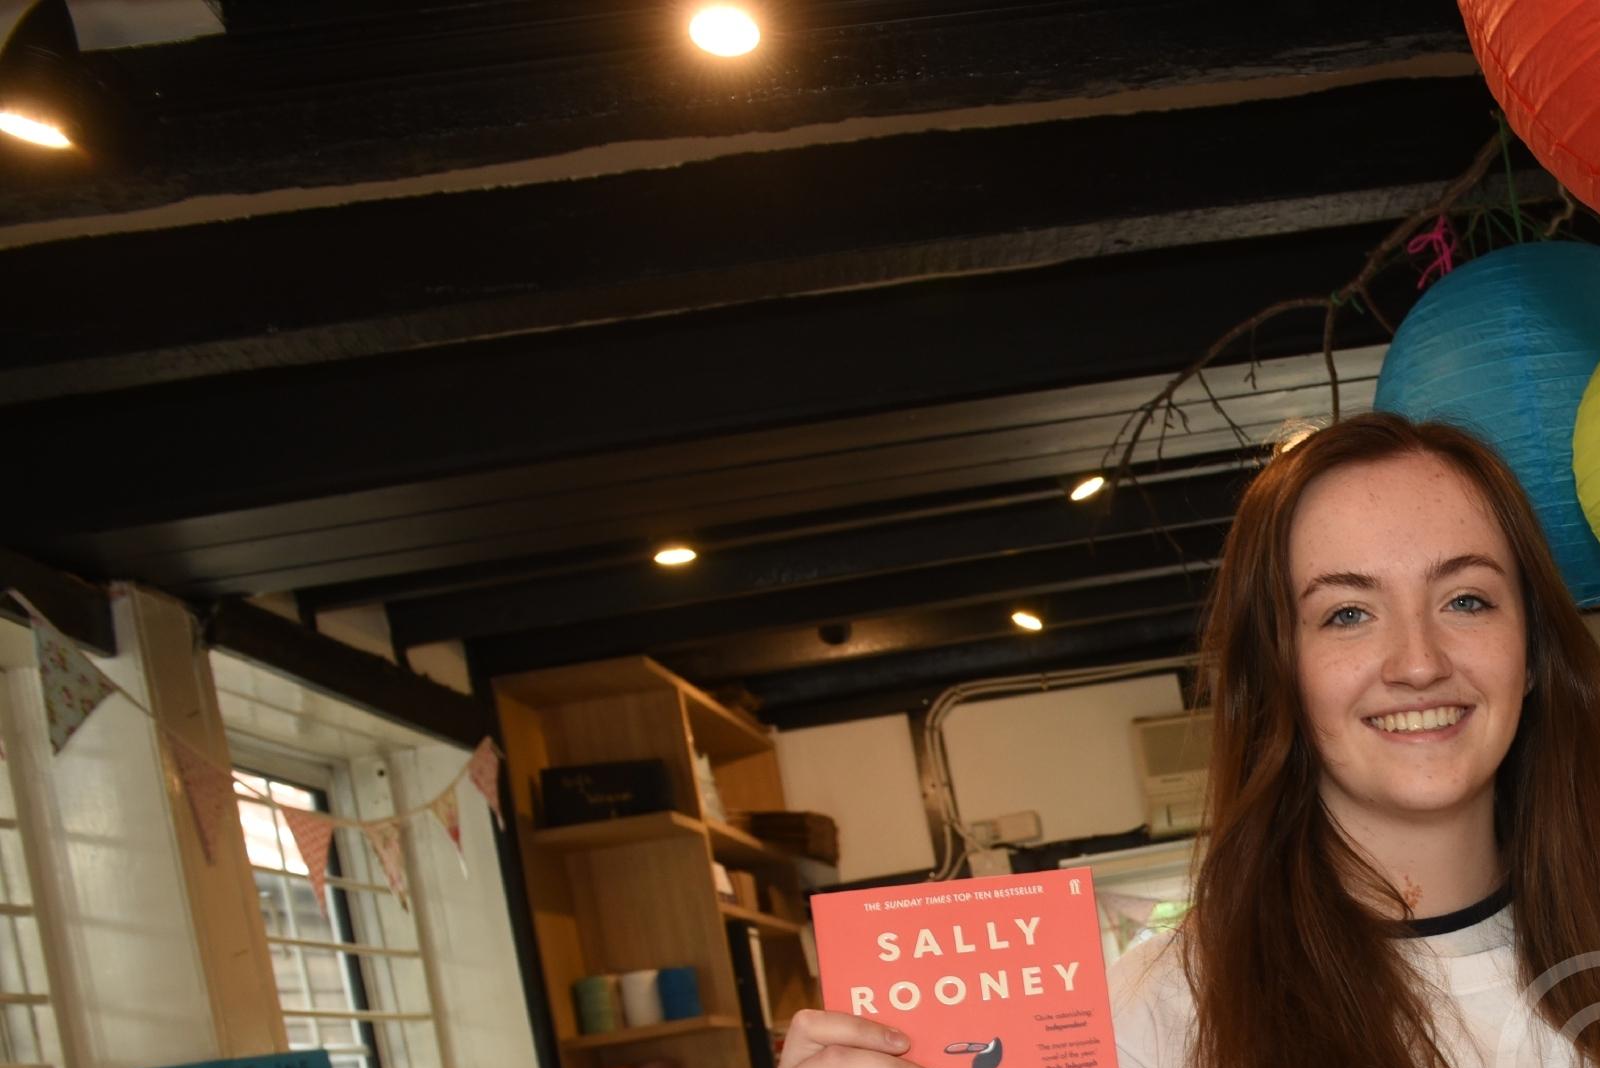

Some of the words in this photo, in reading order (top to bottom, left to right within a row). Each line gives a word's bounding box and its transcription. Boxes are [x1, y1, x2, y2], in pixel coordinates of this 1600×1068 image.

[864, 902, 881, 913] THE
[885, 898, 922, 911] SUNDAY
[925, 895, 952, 906] TIMES
[954, 892, 972, 903] TOP
[974, 890, 992, 901] TEN
[994, 885, 1044, 900] BESTSELLER
[877, 916, 1041, 962] SALLY
[850, 961, 1080, 1016] ROONEY
